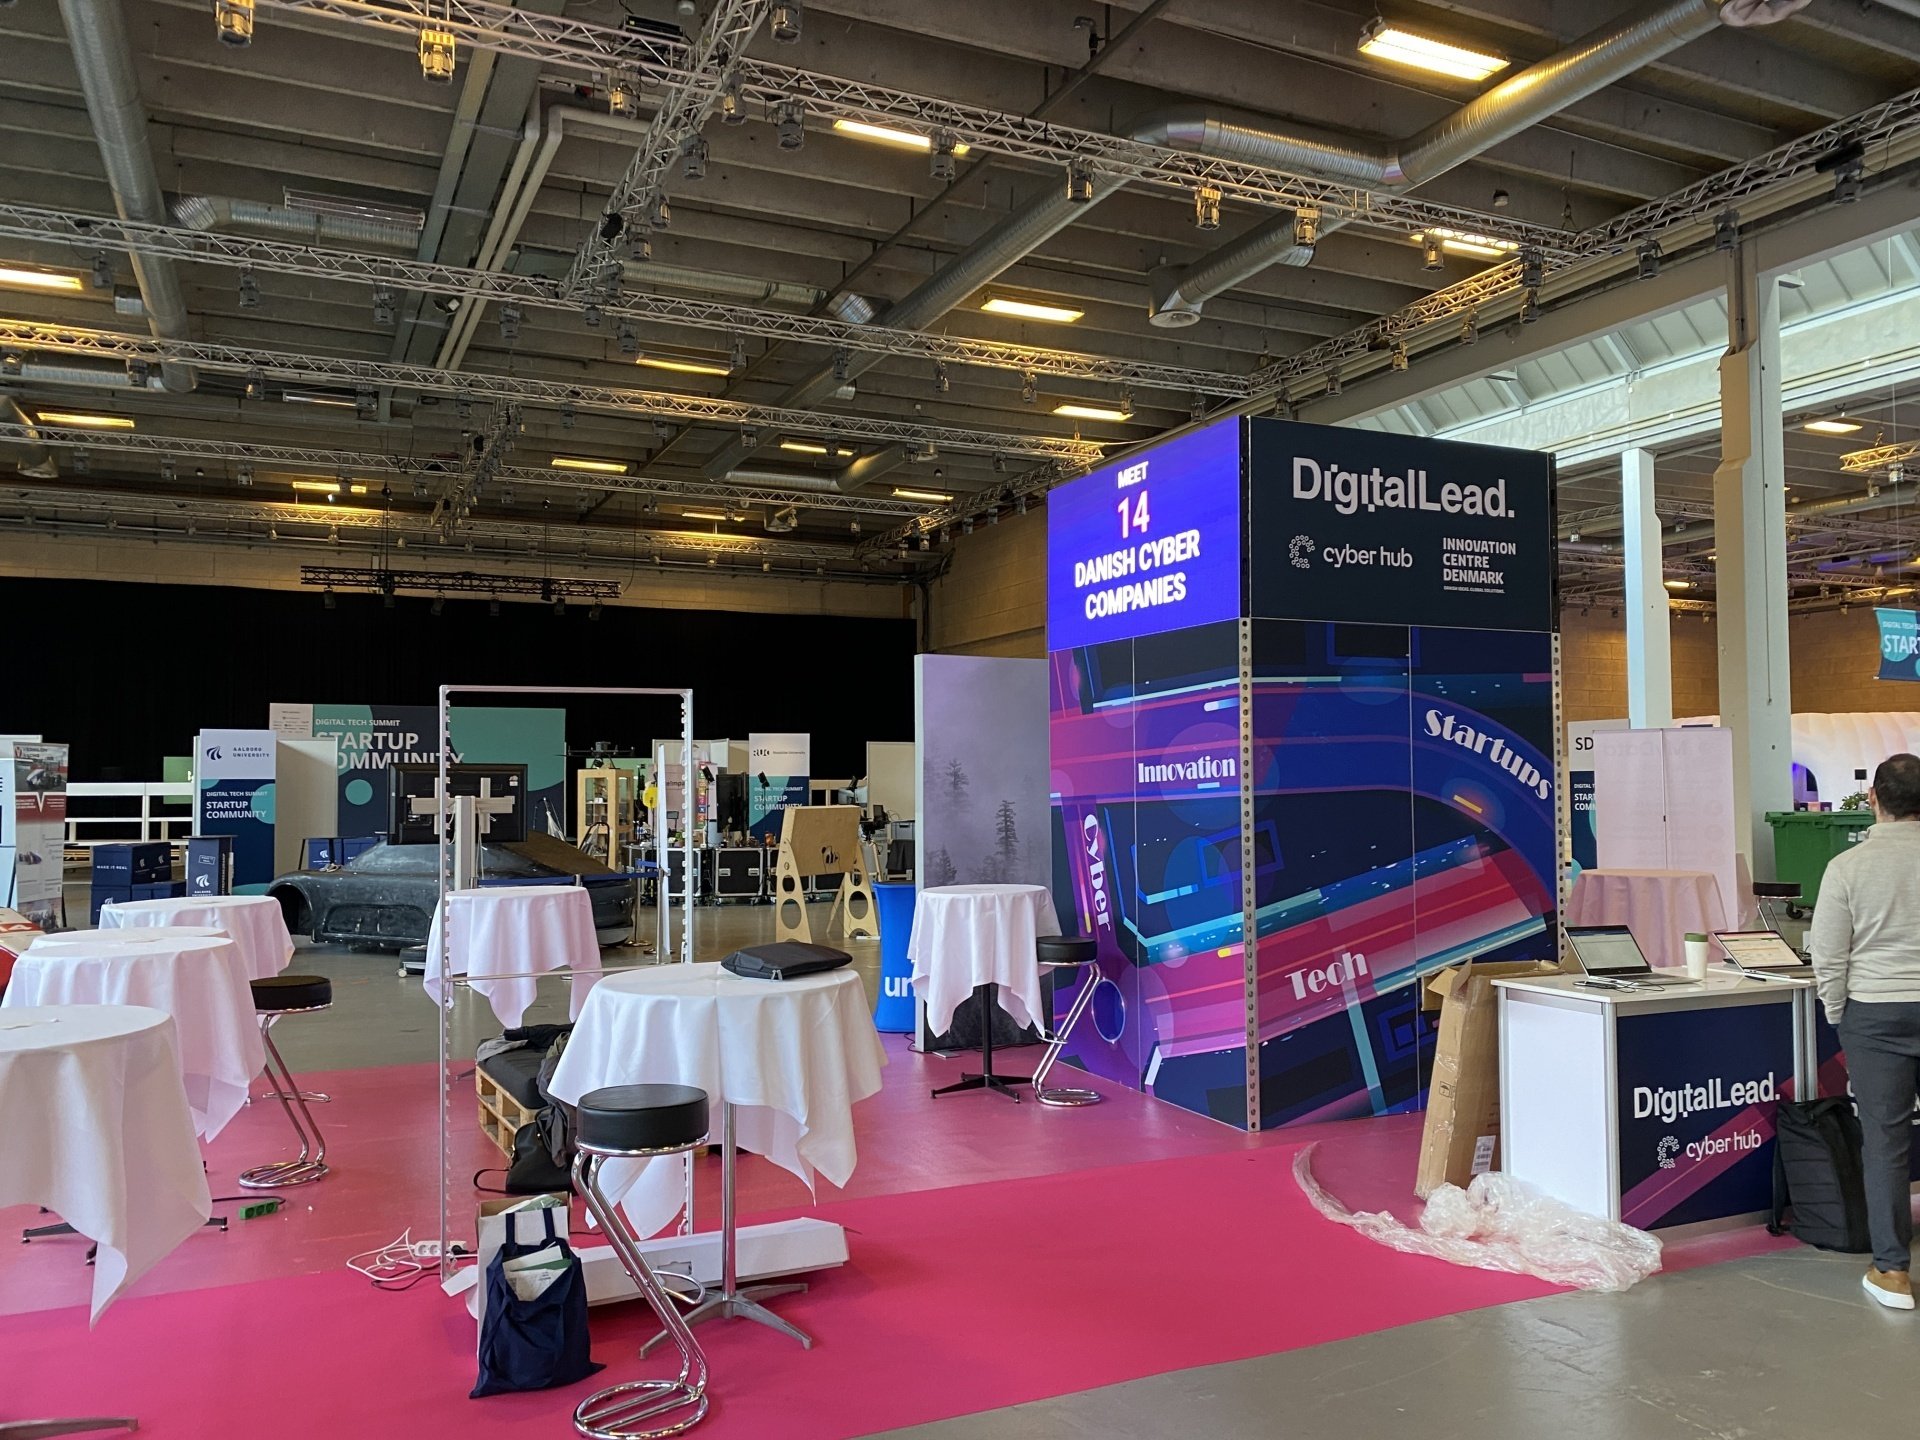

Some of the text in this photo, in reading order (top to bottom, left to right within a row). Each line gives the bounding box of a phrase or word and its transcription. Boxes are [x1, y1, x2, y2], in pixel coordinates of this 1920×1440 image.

[1118, 461, 1149, 489] MEET
[1292, 457, 1515, 518] DigitalLead.
[1116, 491, 1150, 539] 14
[1074, 529, 1200, 588] DANISH CYBER
[1323, 543, 1413, 568] cyber hub
[1443, 537, 1516, 555] INNOVATION
[1443, 553, 1489, 568] CENTRE
[1443, 568, 1504, 584] DENMARK
[1085, 573, 1187, 620] COMPANIES
[369, 719, 400, 727] SUMMIT
[1137, 755, 1236, 784] Innovation
[1423, 709, 1553, 800] Startups
[206, 801, 248, 809] STARTUP
[1083, 814, 1111, 931] Cyber
[1284, 951, 1369, 1000] Tech
[1633, 1071, 1781, 1123] DigitalLead.
[1686, 1129, 1762, 1161] cyber hub
